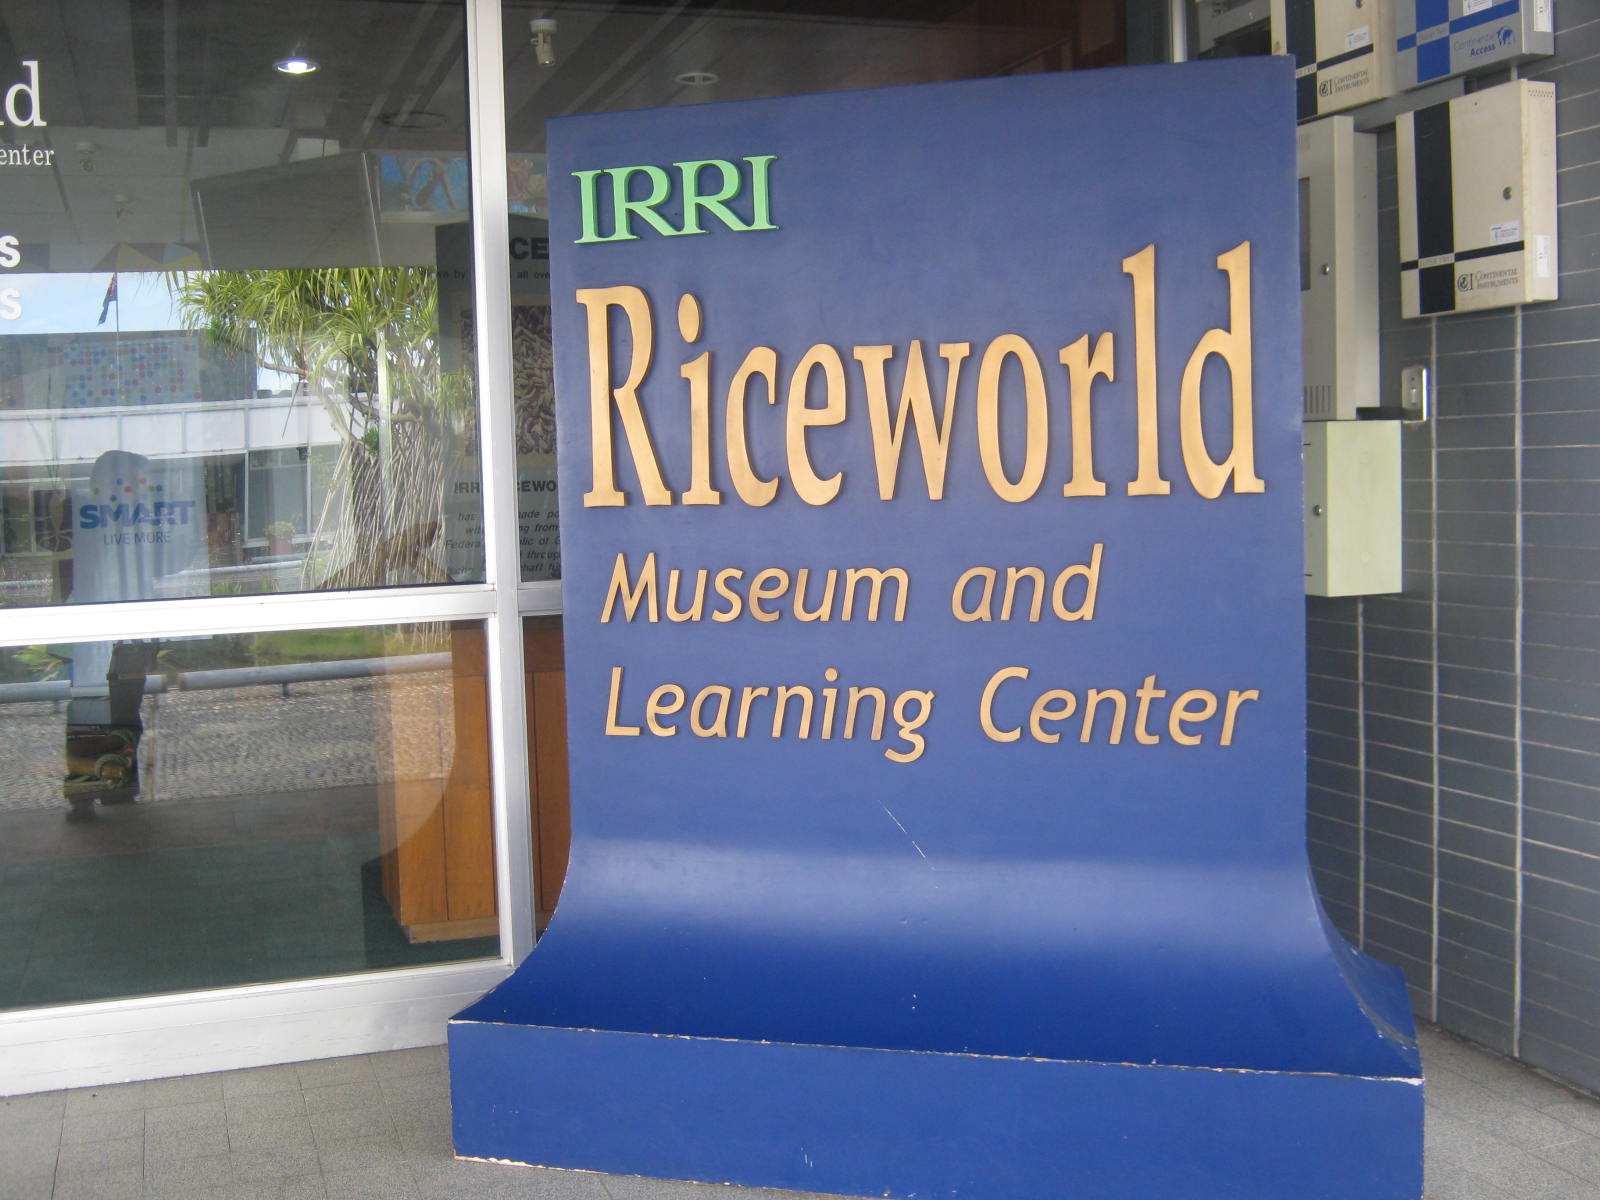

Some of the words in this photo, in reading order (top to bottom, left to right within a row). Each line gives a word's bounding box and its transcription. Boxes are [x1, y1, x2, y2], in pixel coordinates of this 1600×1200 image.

[1470, 43, 1496, 57] Access
[0, 60, 47, 127] d
[571, 155, 779, 245] IRRI
[575, 240, 1266, 508] Riceworld
[80, 501, 196, 530] SMART
[104, 532, 130, 545] LIVE
[134, 531, 172, 545] MORE
[600, 551, 909, 624] Museum
[950, 543, 1104, 623] and
[604, 665, 936, 764] Learning
[980, 665, 1260, 746] Center
